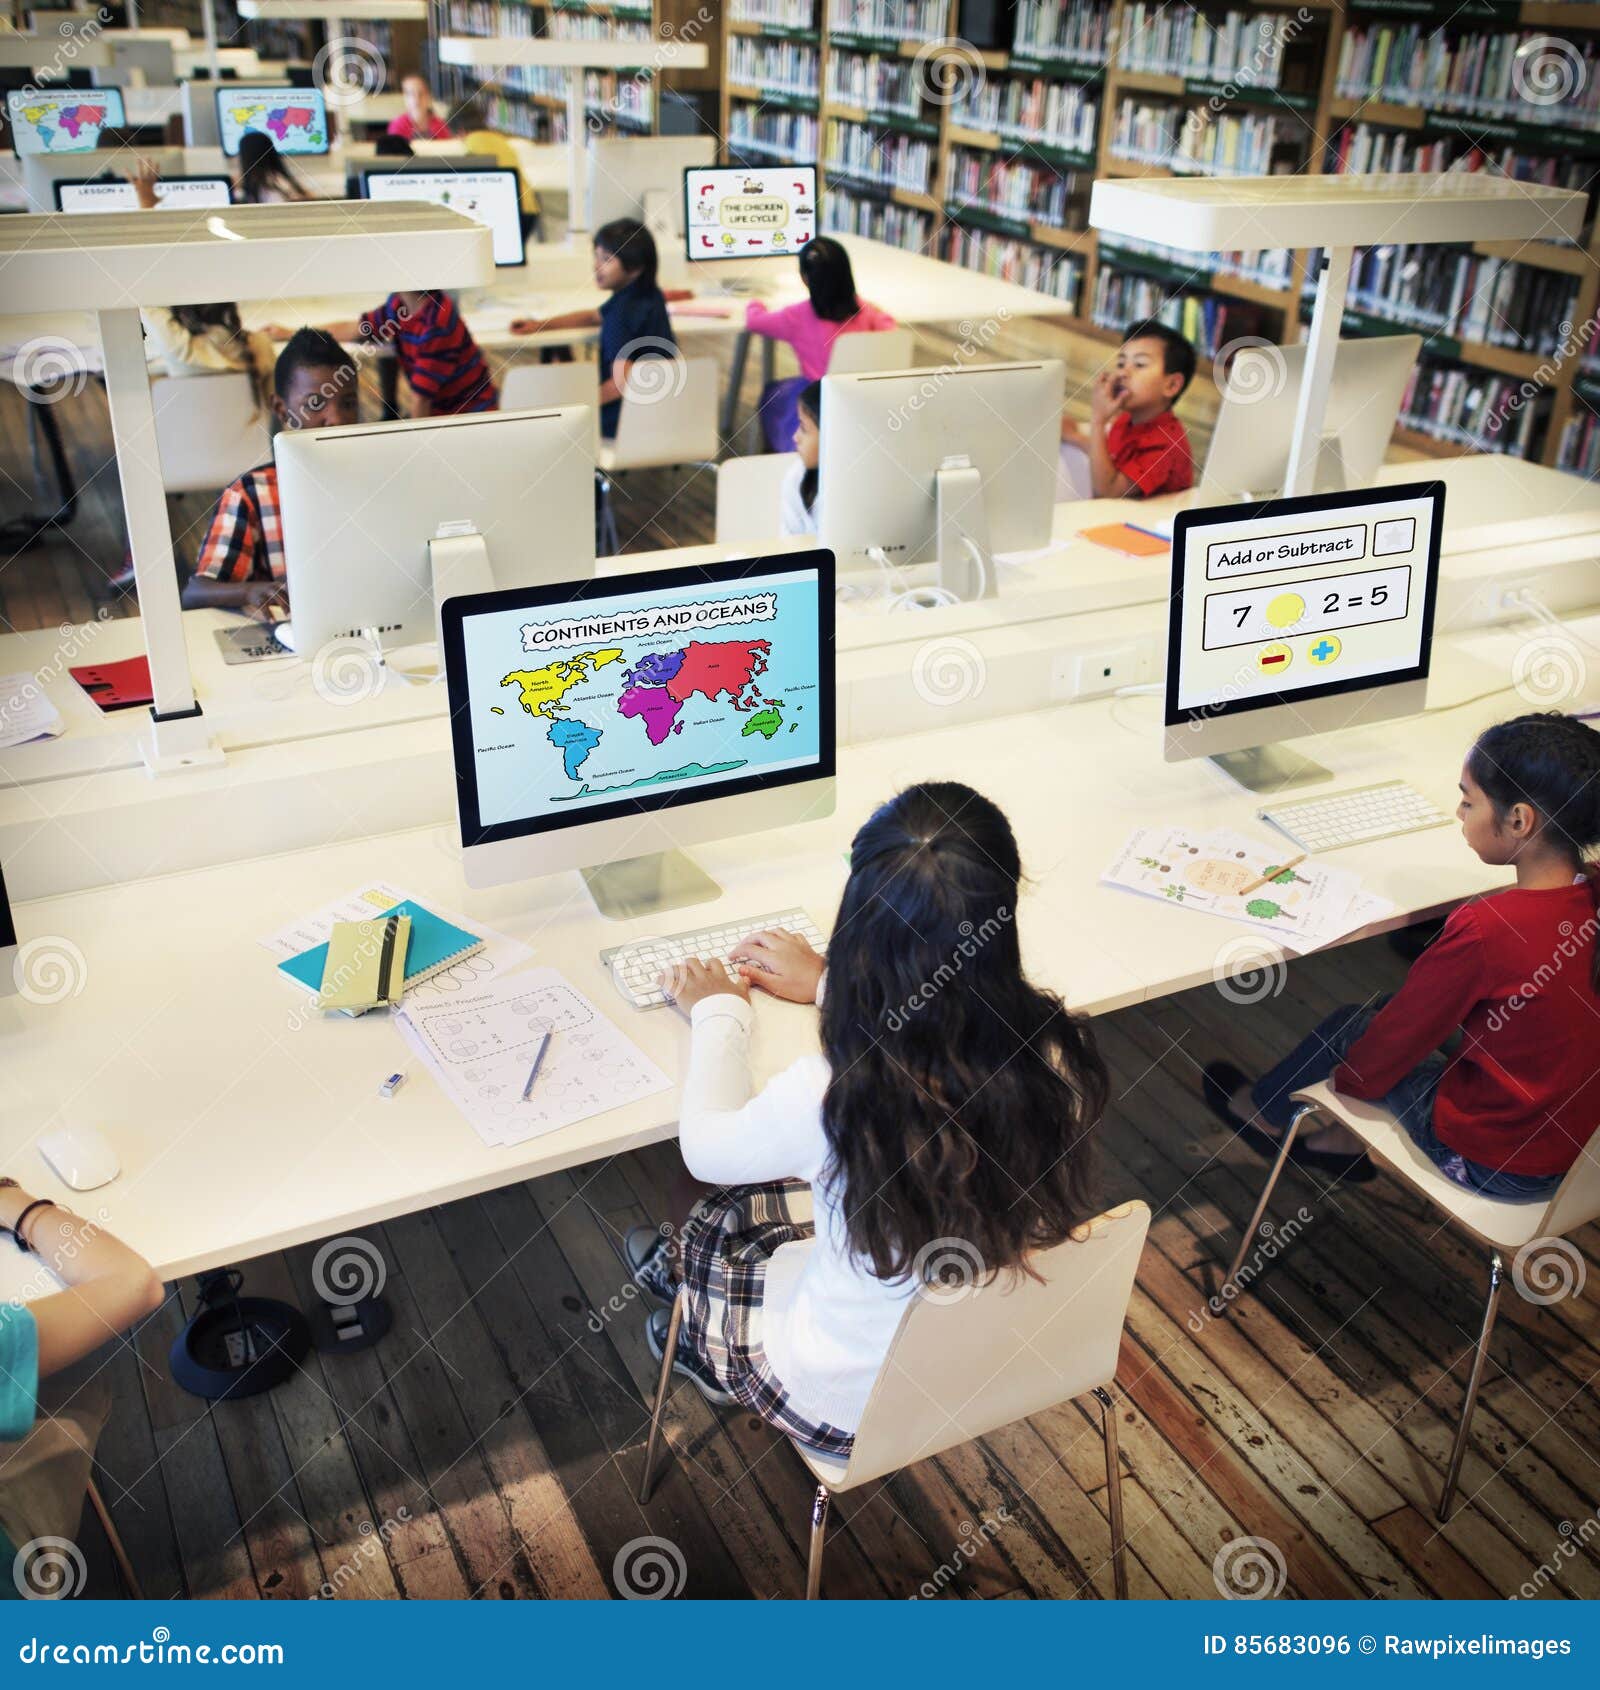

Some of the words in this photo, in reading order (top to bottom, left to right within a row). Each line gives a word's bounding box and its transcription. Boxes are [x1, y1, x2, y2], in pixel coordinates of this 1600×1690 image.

[743, 203, 783, 212] CHICKEN
[749, 215, 778, 223] CYCLE
[1217, 549, 1252, 567] Add
[1256, 550, 1275, 562] or
[1278, 537, 1354, 559] Subtract
[1232, 605, 1252, 628] 7
[1322, 593, 1341, 613] 2
[1370, 585, 1388, 606] 5
[532, 617, 650, 644] CONTINENTS
[653, 611, 692, 628] AND
[696, 602, 768, 621] OCEANS
[573, 694, 596, 702] Atlantic
[497, 743, 515, 751] Ocean
